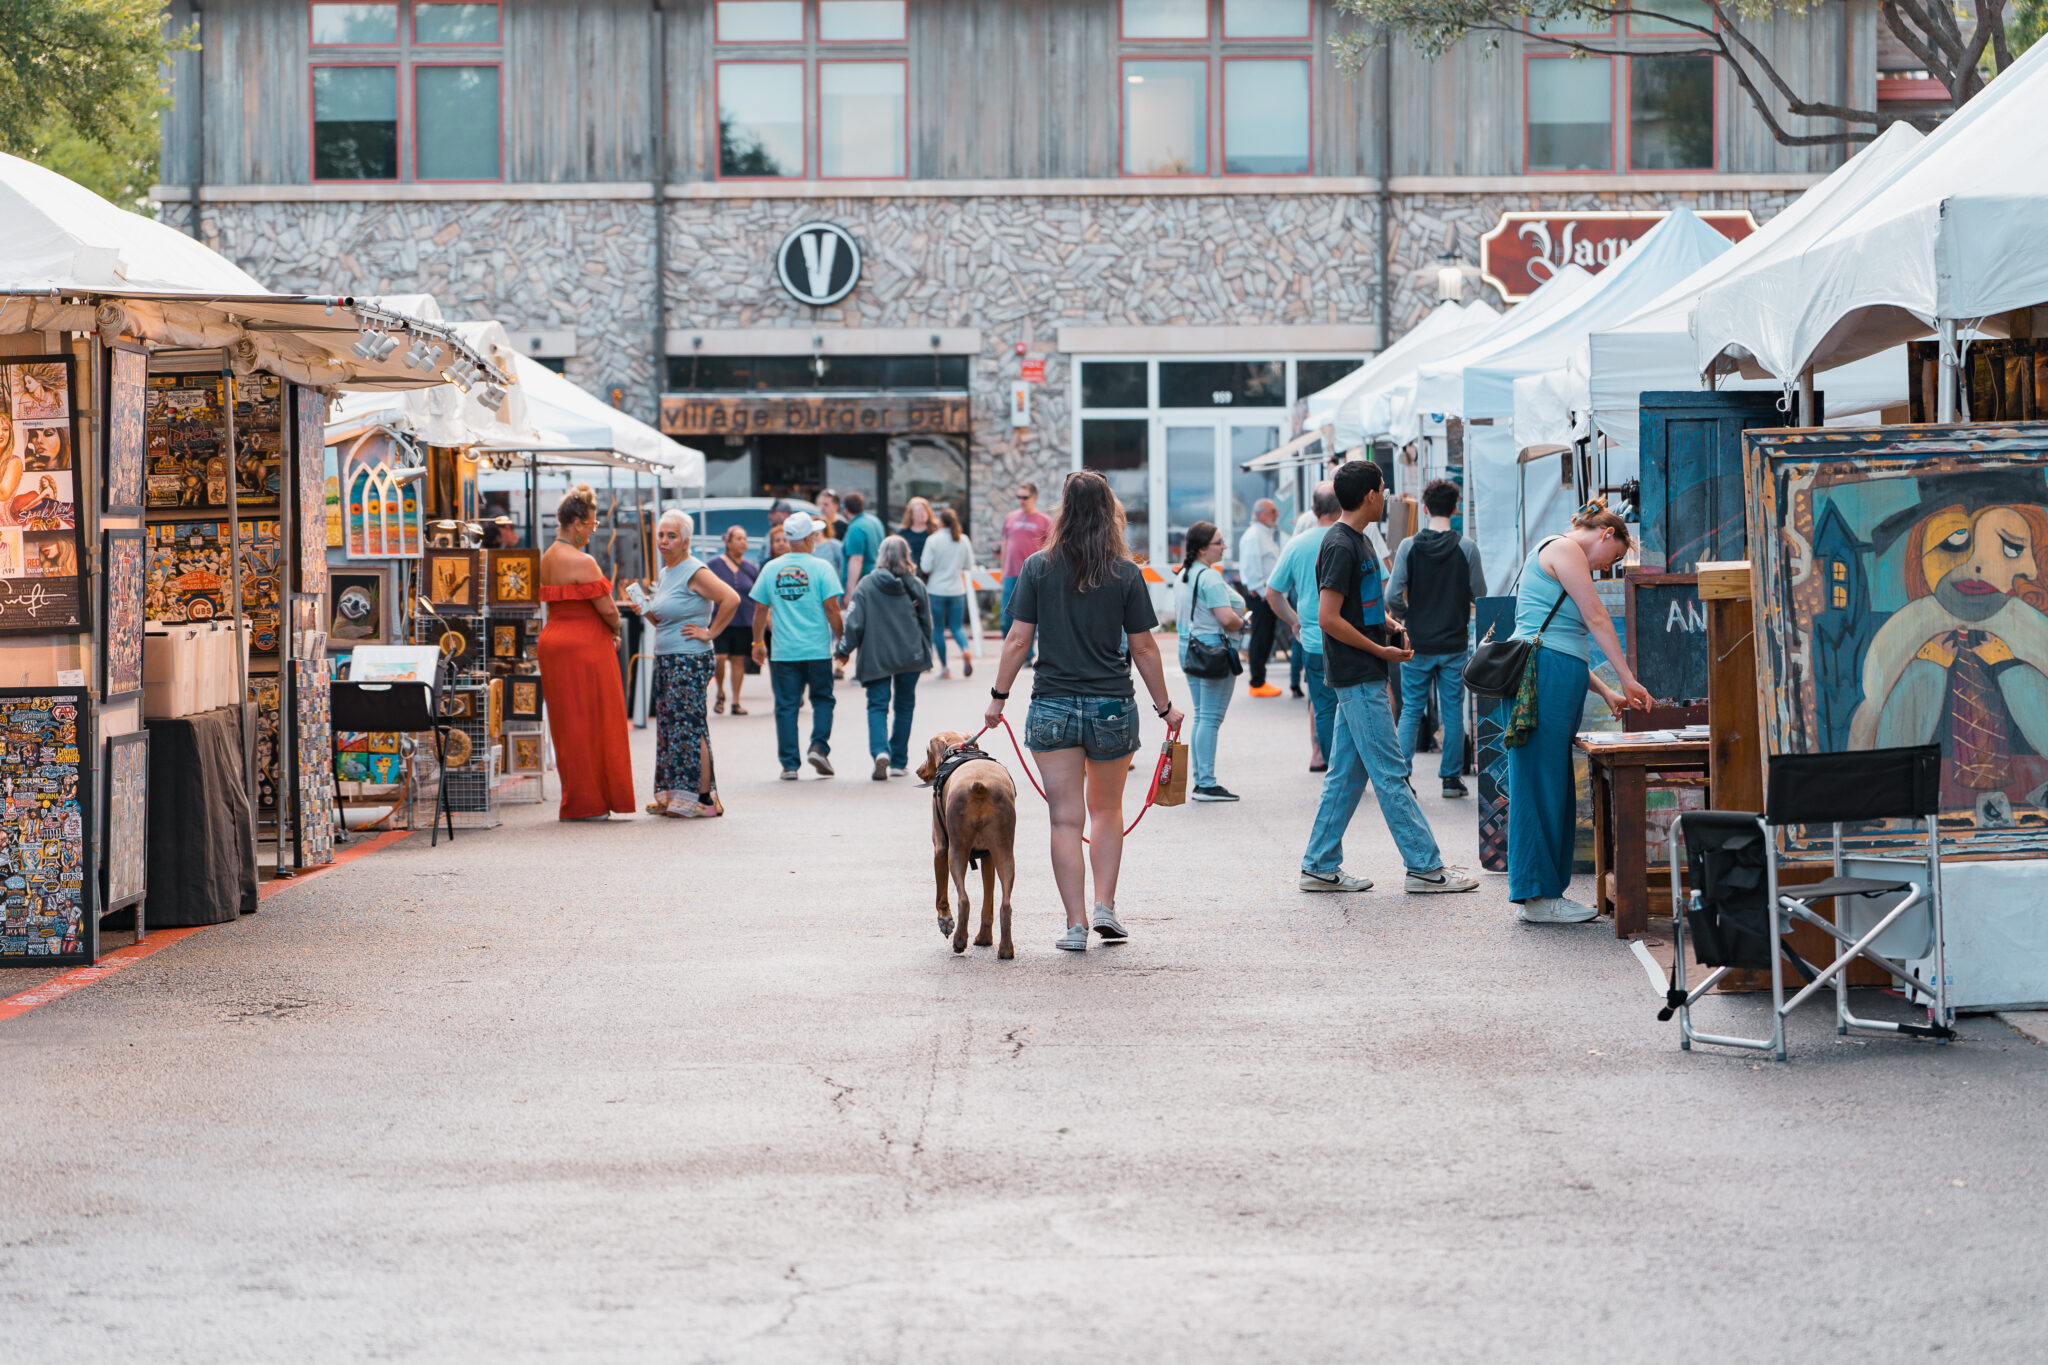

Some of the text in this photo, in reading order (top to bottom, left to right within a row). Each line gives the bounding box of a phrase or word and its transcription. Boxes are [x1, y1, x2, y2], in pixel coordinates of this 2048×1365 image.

[800, 233, 838, 297] V
[664, 403, 961, 431] village burger bar
[17, 500, 50, 524] Speak
[27, 558, 41, 568] RED
[203, 573, 221, 582] FIELD
[37, 792, 60, 800] NIRVANA
